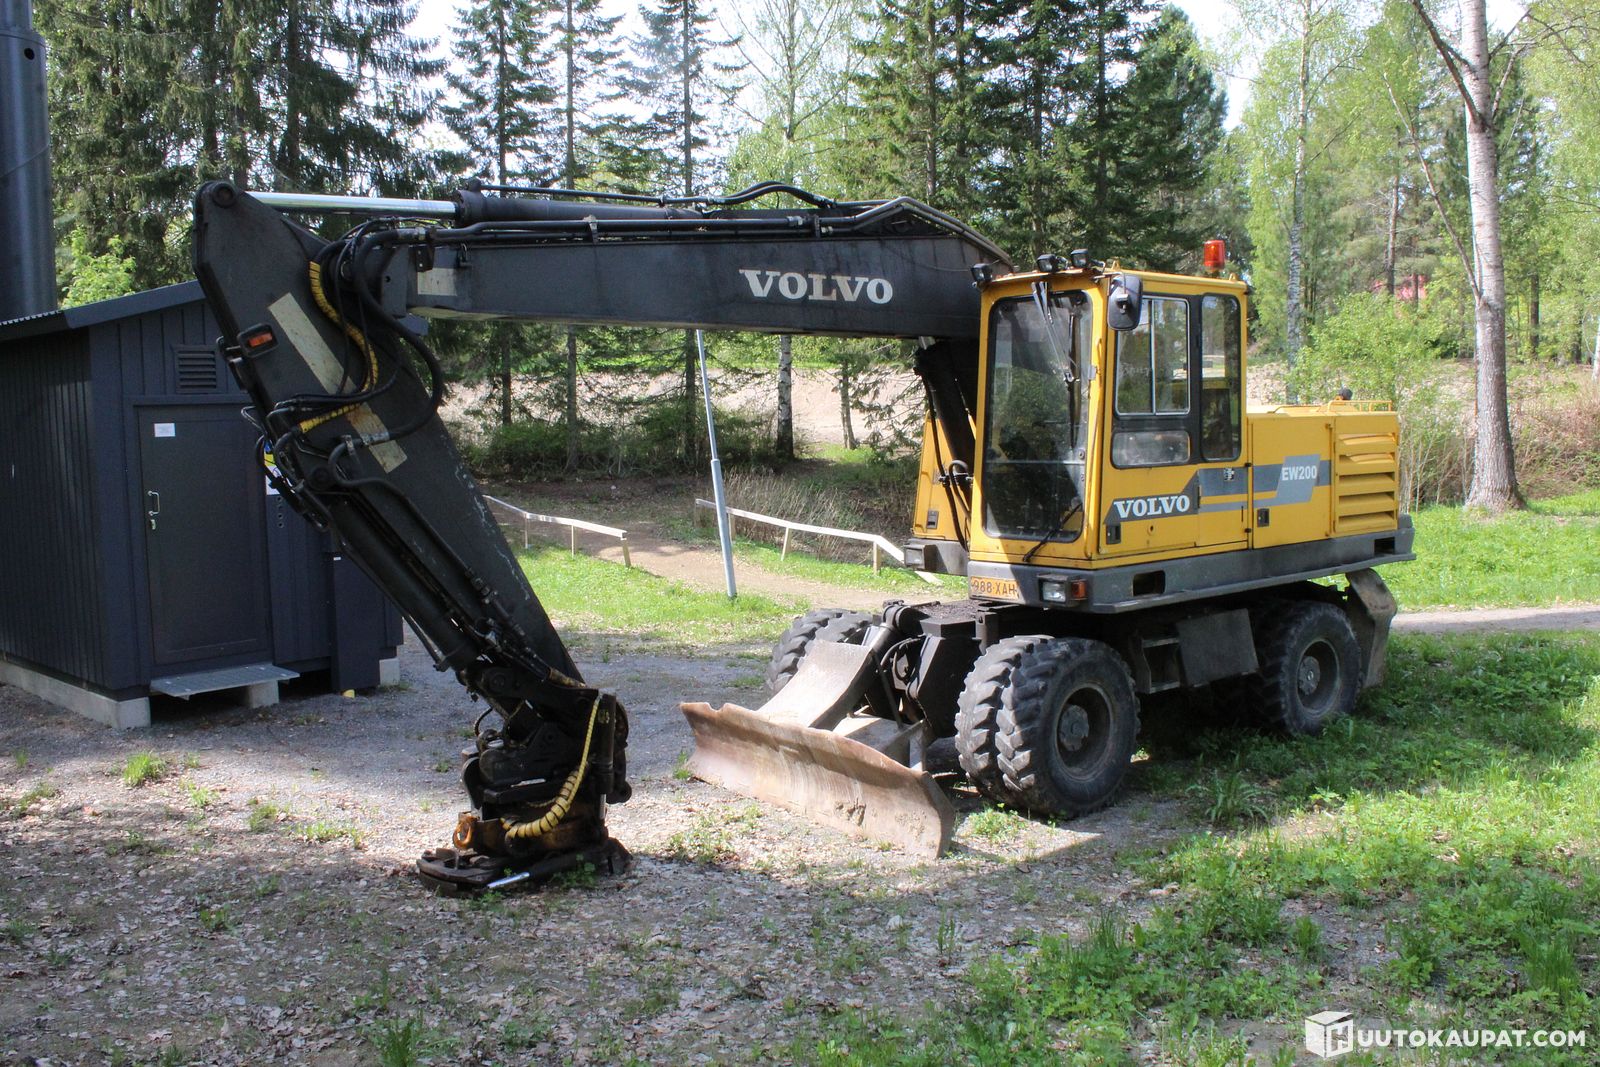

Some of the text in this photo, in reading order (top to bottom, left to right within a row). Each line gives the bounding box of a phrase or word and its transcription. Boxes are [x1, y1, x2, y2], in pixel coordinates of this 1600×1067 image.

[738, 268, 894, 305] VOLVO
[1281, 465, 1318, 481] EW200
[1113, 494, 1191, 519] VOLVO
